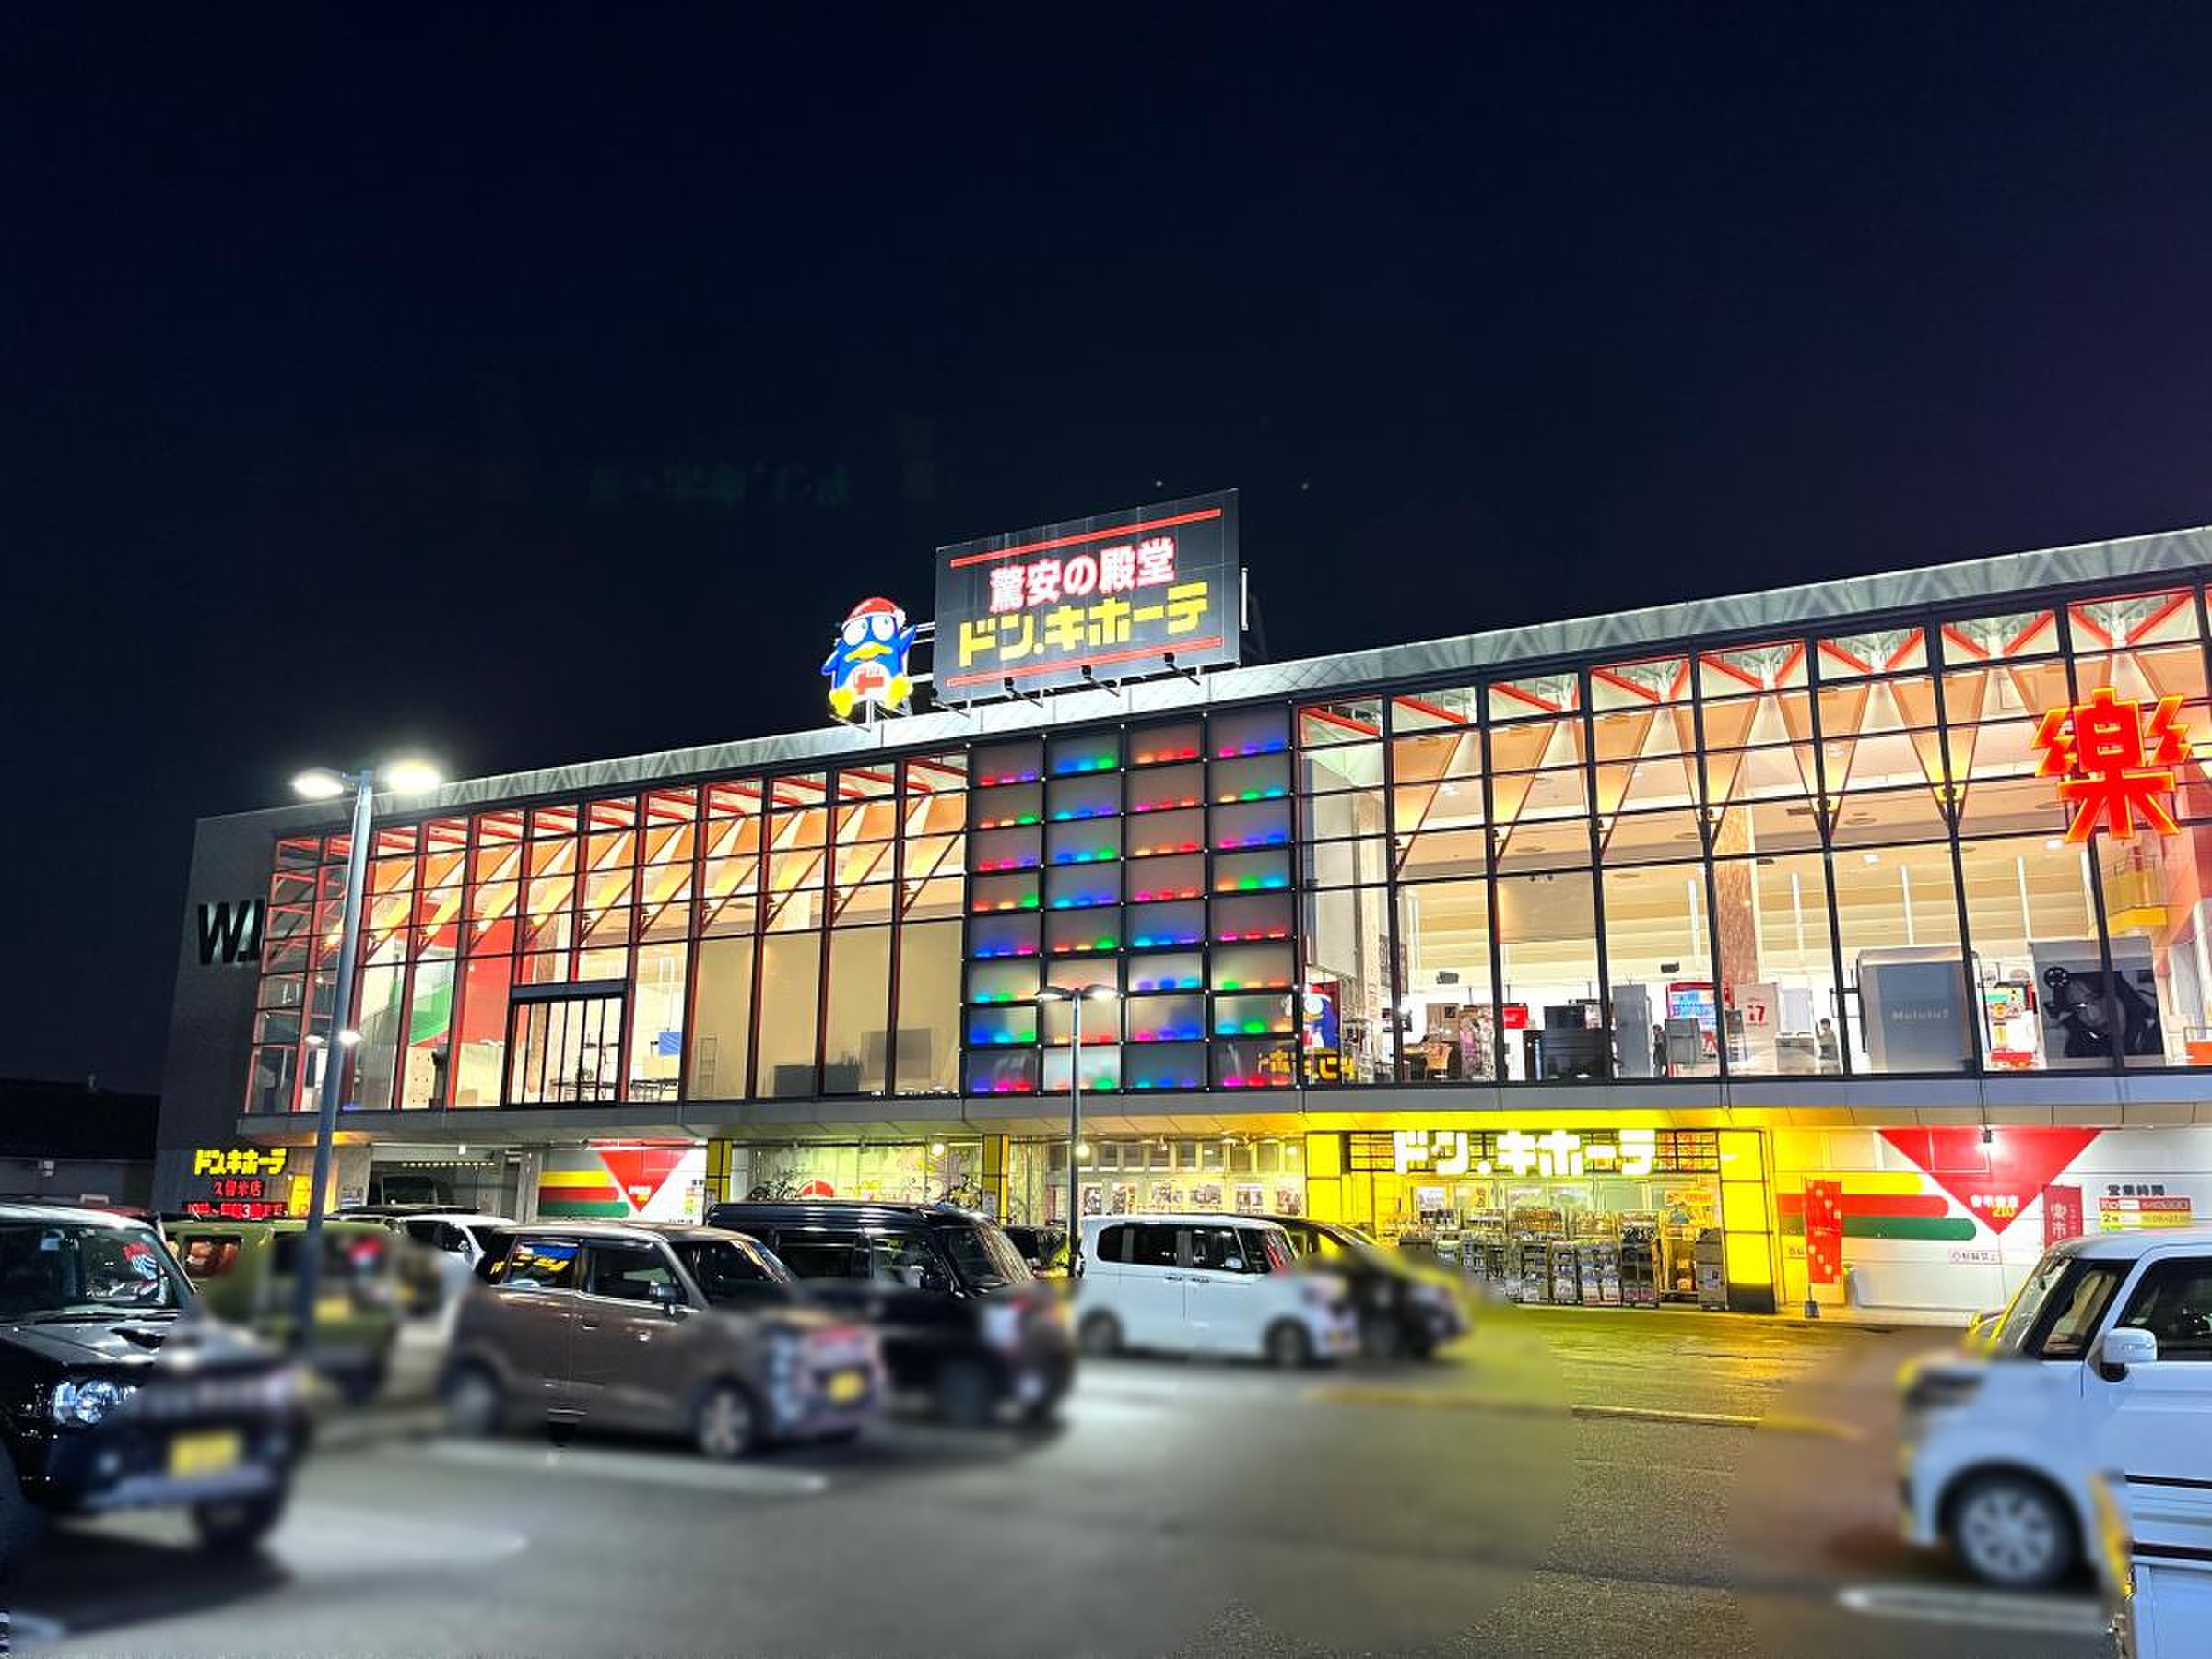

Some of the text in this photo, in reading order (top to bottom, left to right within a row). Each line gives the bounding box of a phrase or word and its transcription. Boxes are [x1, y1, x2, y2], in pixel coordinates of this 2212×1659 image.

[989, 535, 1176, 614] 驚安の殿堂
[959, 582, 1209, 667] ドン.キホーテ
